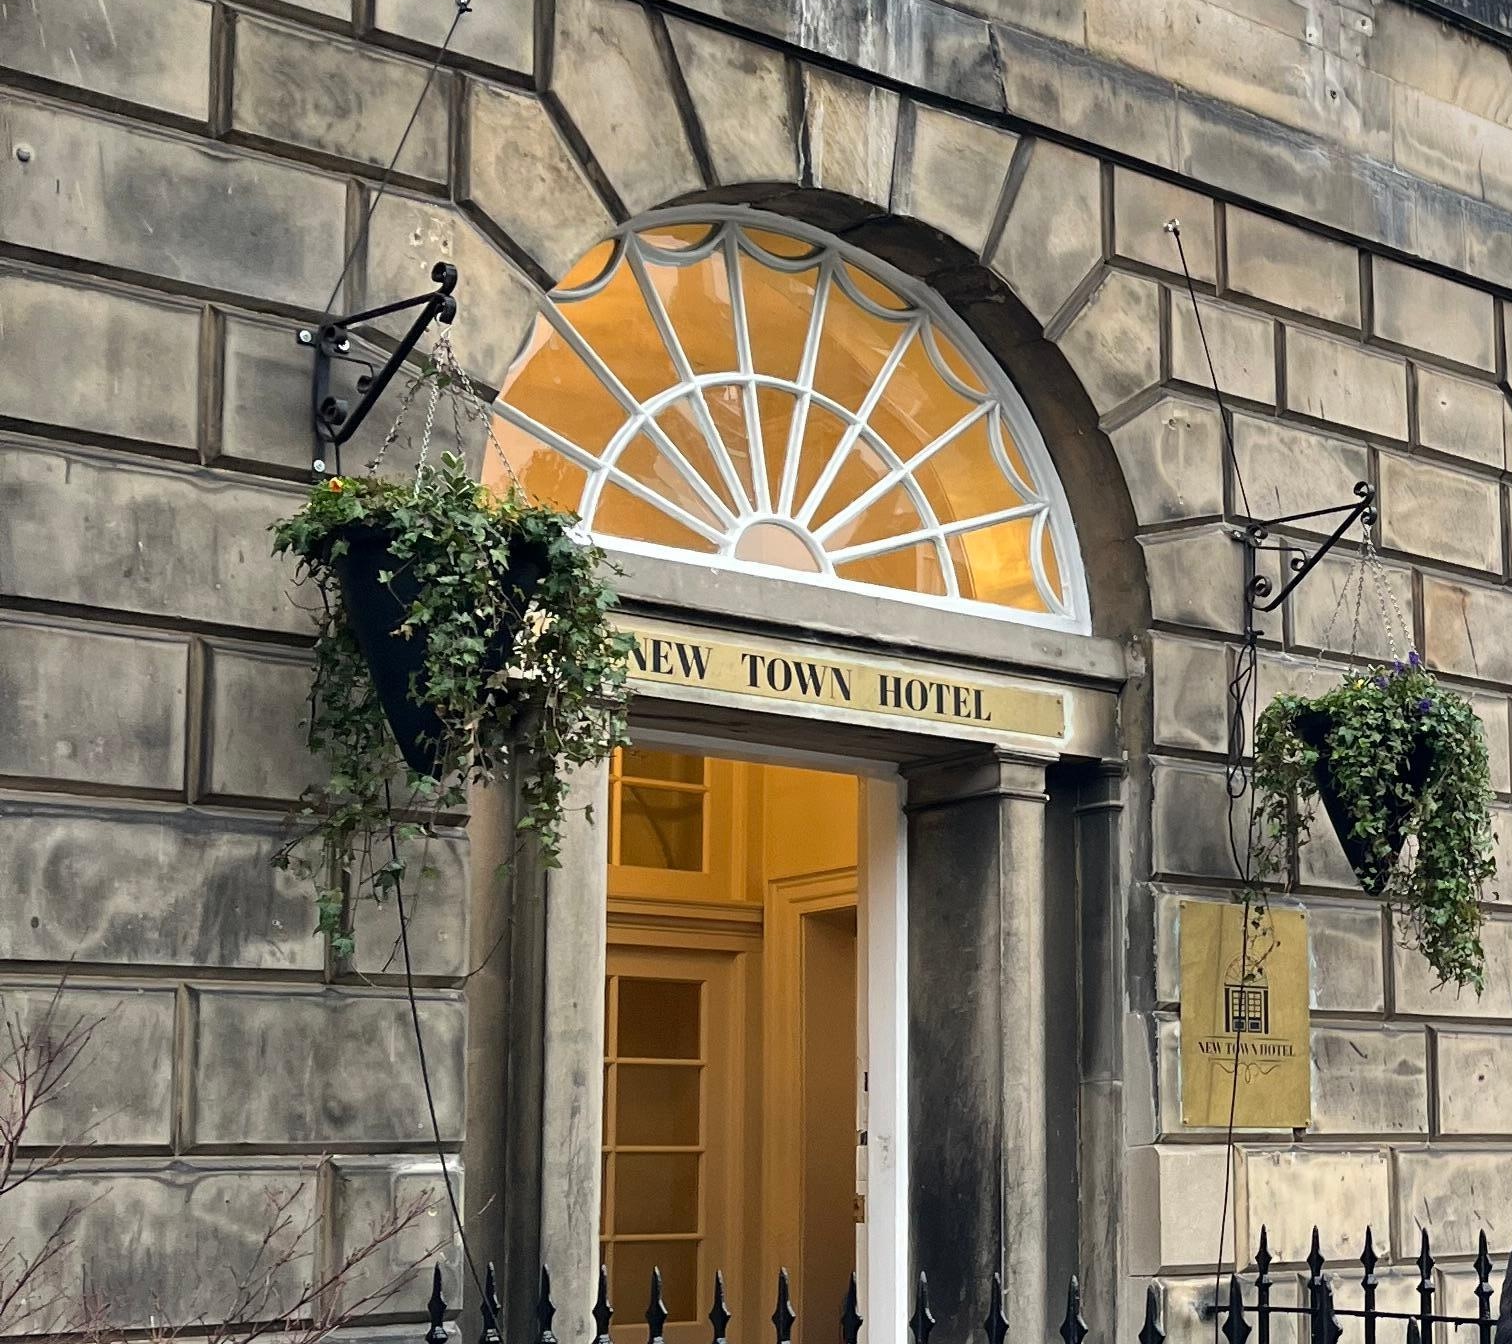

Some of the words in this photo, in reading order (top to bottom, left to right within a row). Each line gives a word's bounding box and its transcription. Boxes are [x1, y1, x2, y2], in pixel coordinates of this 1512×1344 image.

[631, 638, 714, 679] NEW
[741, 653, 853, 701] TOWN
[878, 674, 992, 722] HOTEL
[1198, 1041, 1223, 1054] NEW
[1225, 1042, 1258, 1056] TOWN
[1259, 1043, 1297, 1057] HOTEL
